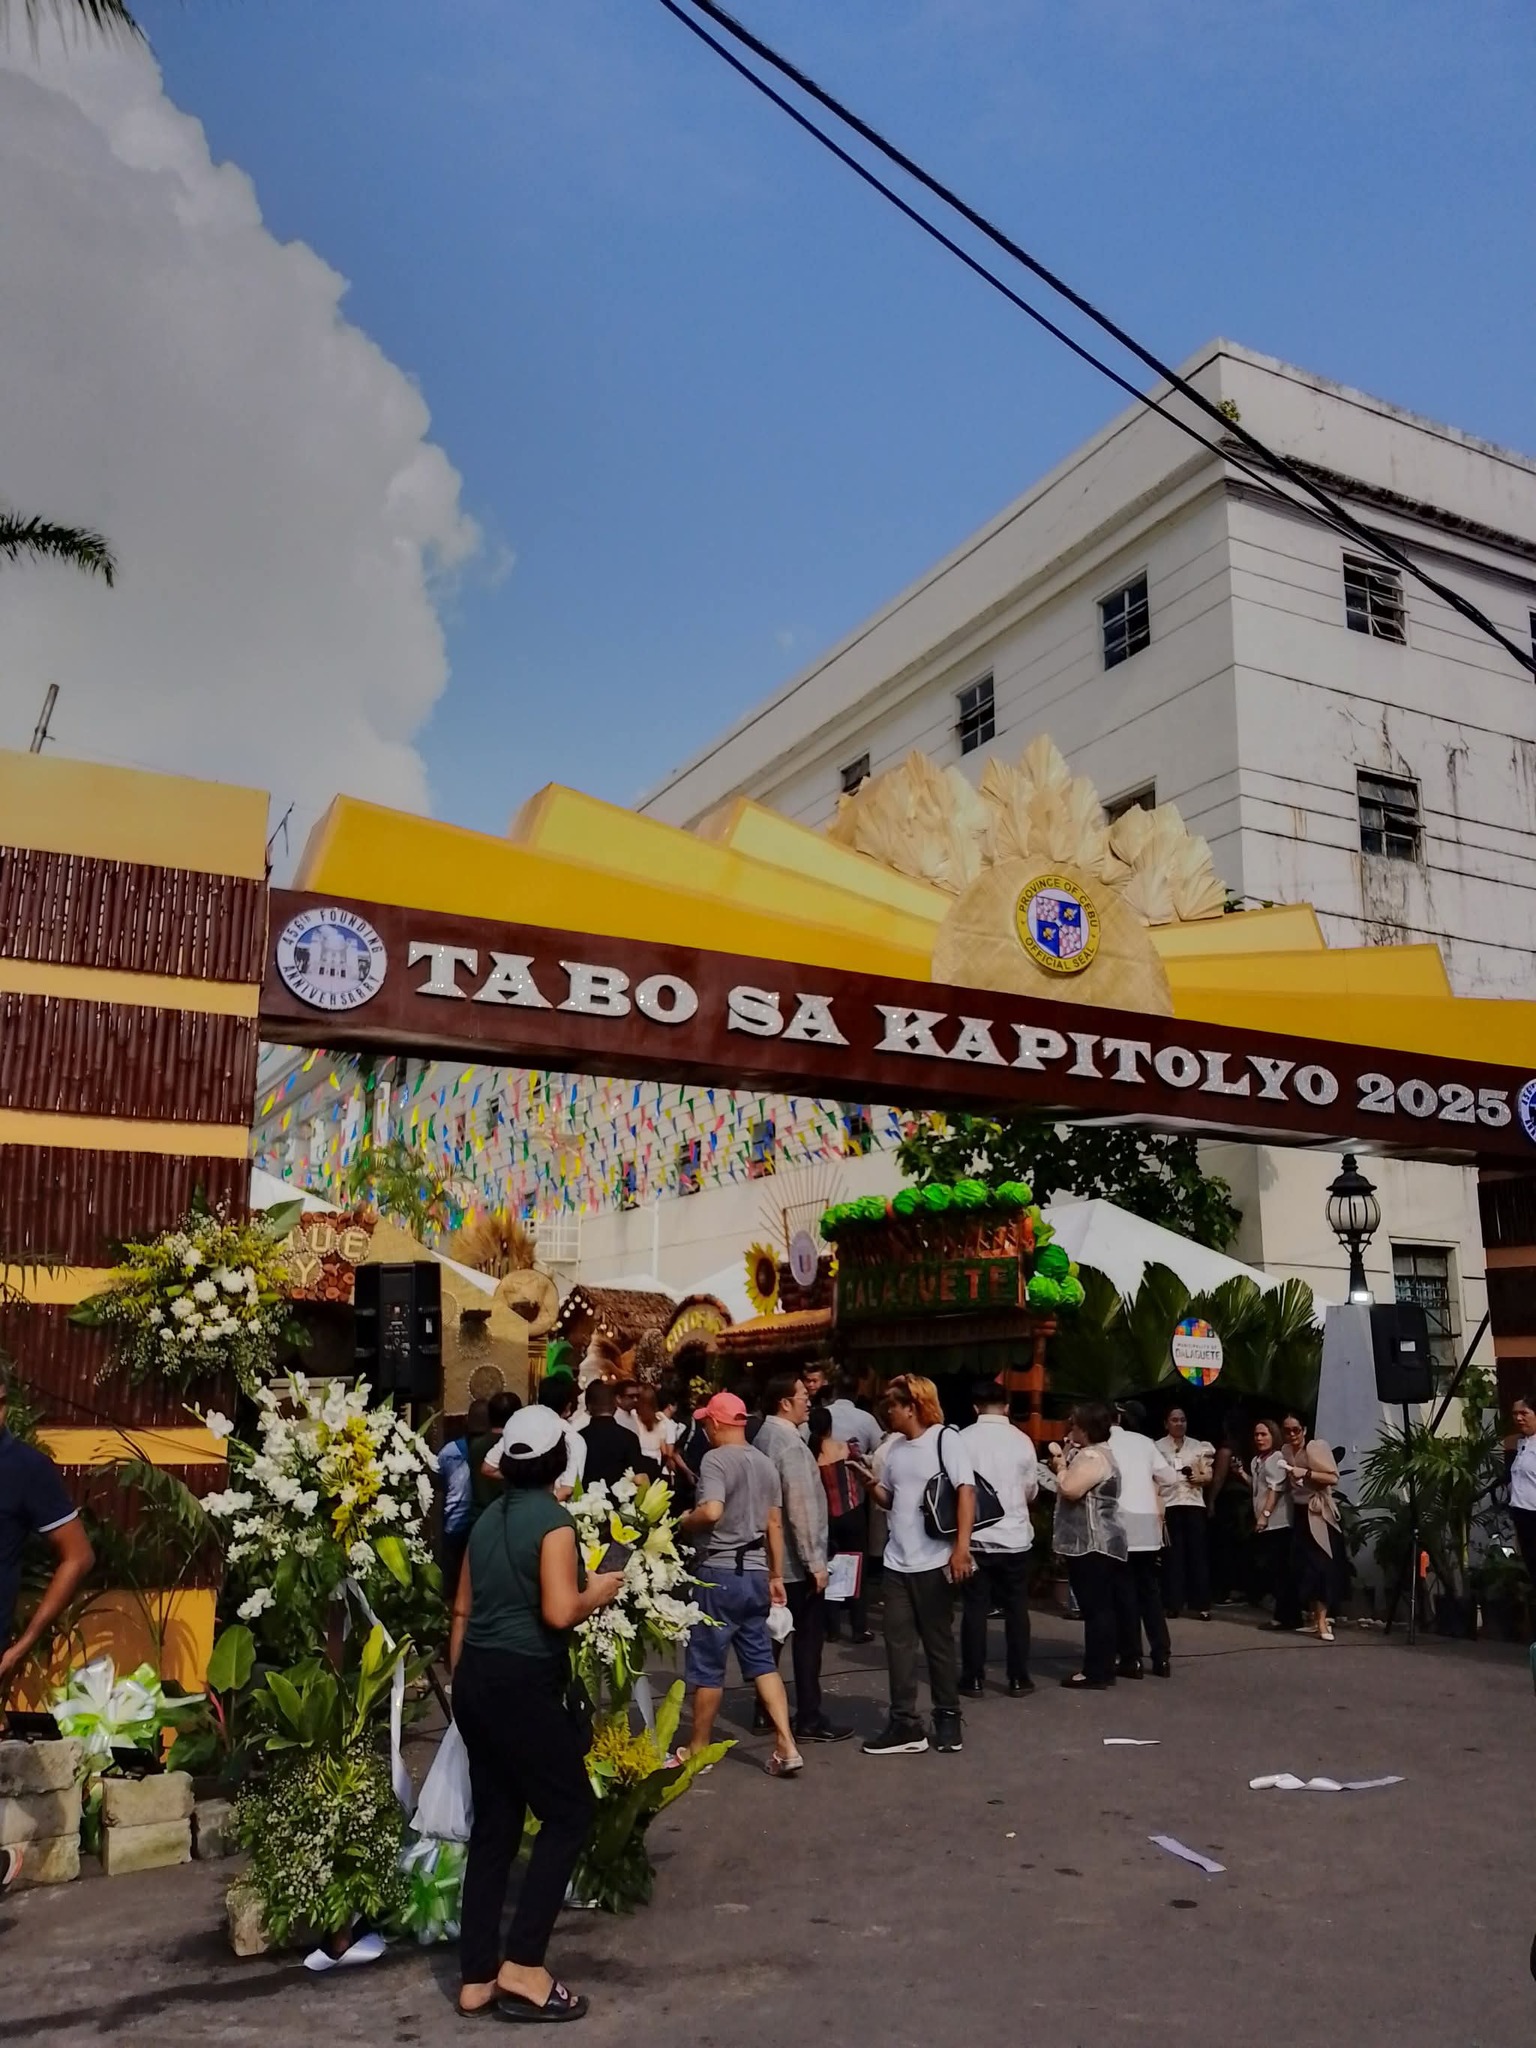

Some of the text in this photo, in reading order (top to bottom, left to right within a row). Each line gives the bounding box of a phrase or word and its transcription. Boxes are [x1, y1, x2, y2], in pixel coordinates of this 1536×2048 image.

[1019, 878, 1098, 928] PROVINCE OF CEBU
[319, 910, 384, 954] FOUNDING
[1025, 937, 1095, 970] OFFICIAL SEAL
[407, 940, 1512, 1127] TABO SA KAPITOLYO 2025
